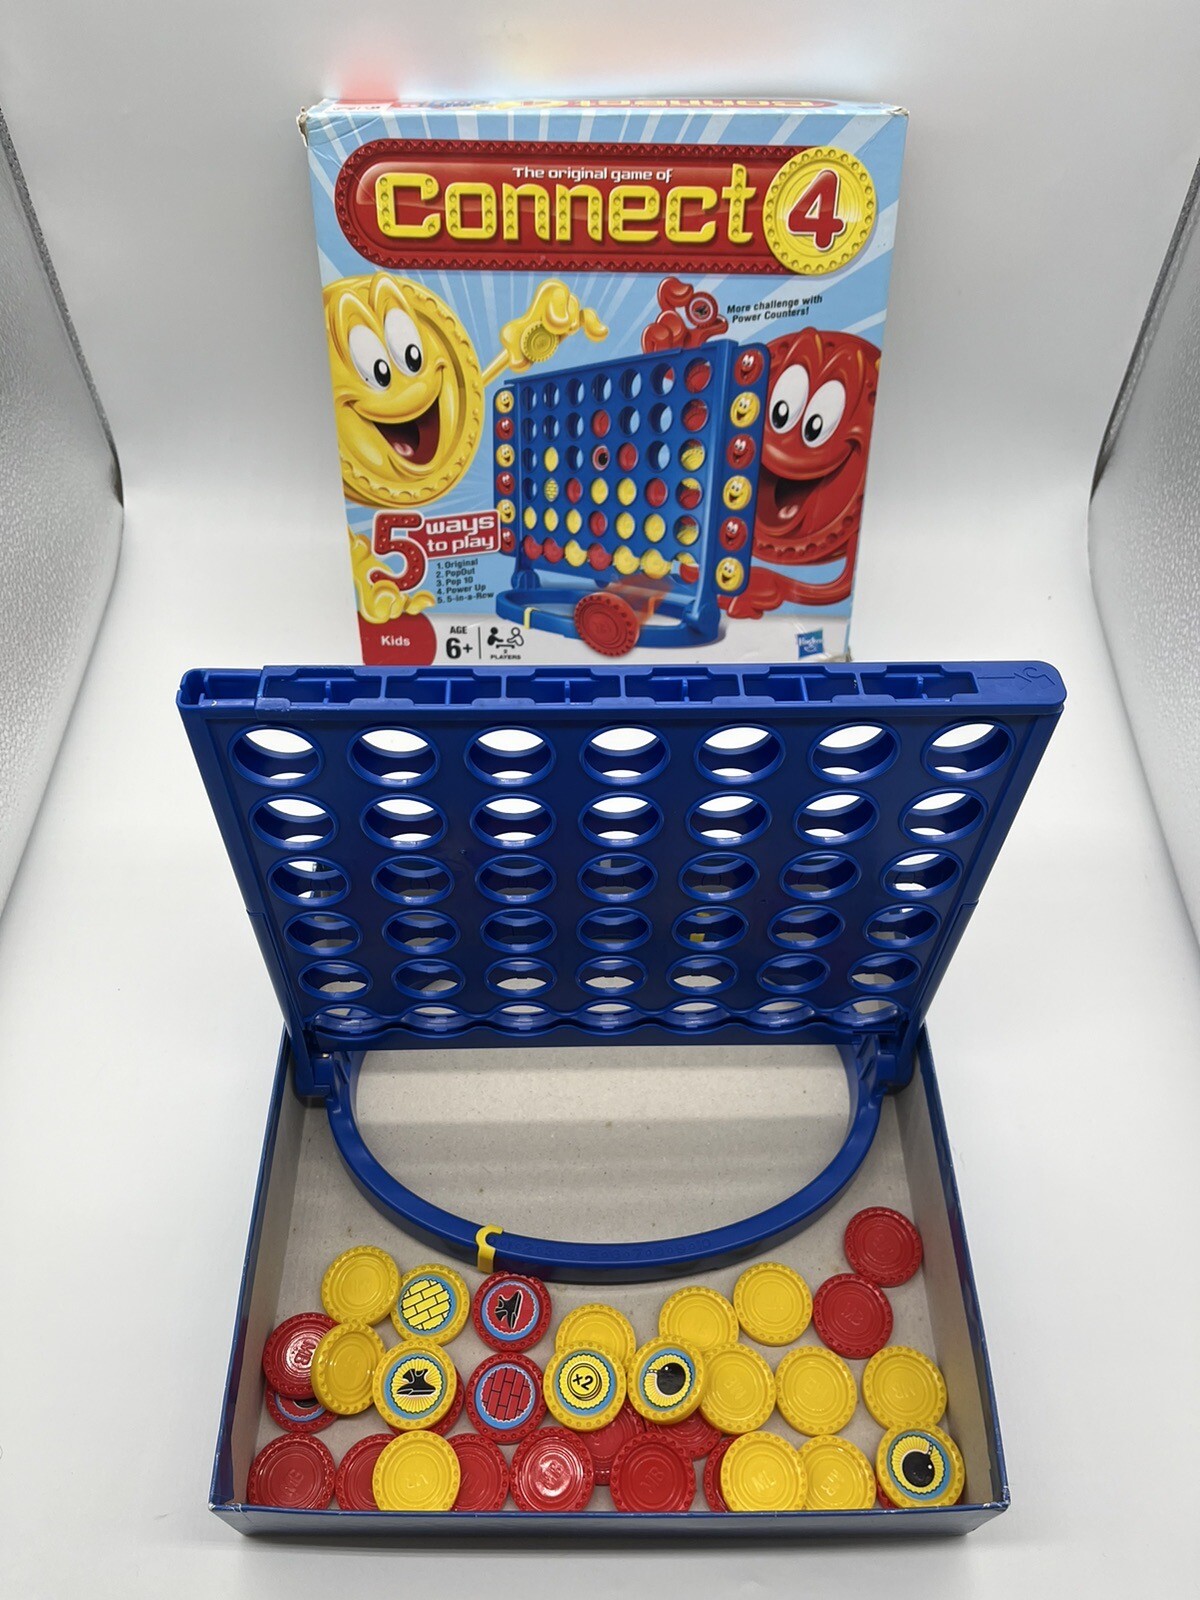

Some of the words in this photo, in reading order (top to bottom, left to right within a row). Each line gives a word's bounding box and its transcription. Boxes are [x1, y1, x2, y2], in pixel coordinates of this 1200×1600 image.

[512, 166, 545, 179] The
[548, 167, 608, 183] original
[611, 169, 653, 184] game
[655, 168, 674, 184] of
[375, 162, 757, 244] Connect
[787, 169, 845, 251] 4
[726, 303, 751, 315] More
[753, 298, 799, 311] challenge
[802, 294, 823, 306] with
[732, 313, 761, 324] Power
[764, 306, 810, 320] Counters!
[367, 509, 428, 592] 5
[425, 515, 495, 537] ways
[427, 539, 448, 553] to
[452, 535, 495, 554] play
[444, 558, 479, 570] Original
[445, 567, 476, 579] PopOut
[446, 578, 462, 588] Pop
[464, 576, 474, 584] 10
[446, 586, 472, 595] Power
[474, 583, 487, 593] Up
[450, 626, 468, 635] AGE
[380, 635, 411, 647] Kids
[445, 637, 473, 660] 6+
